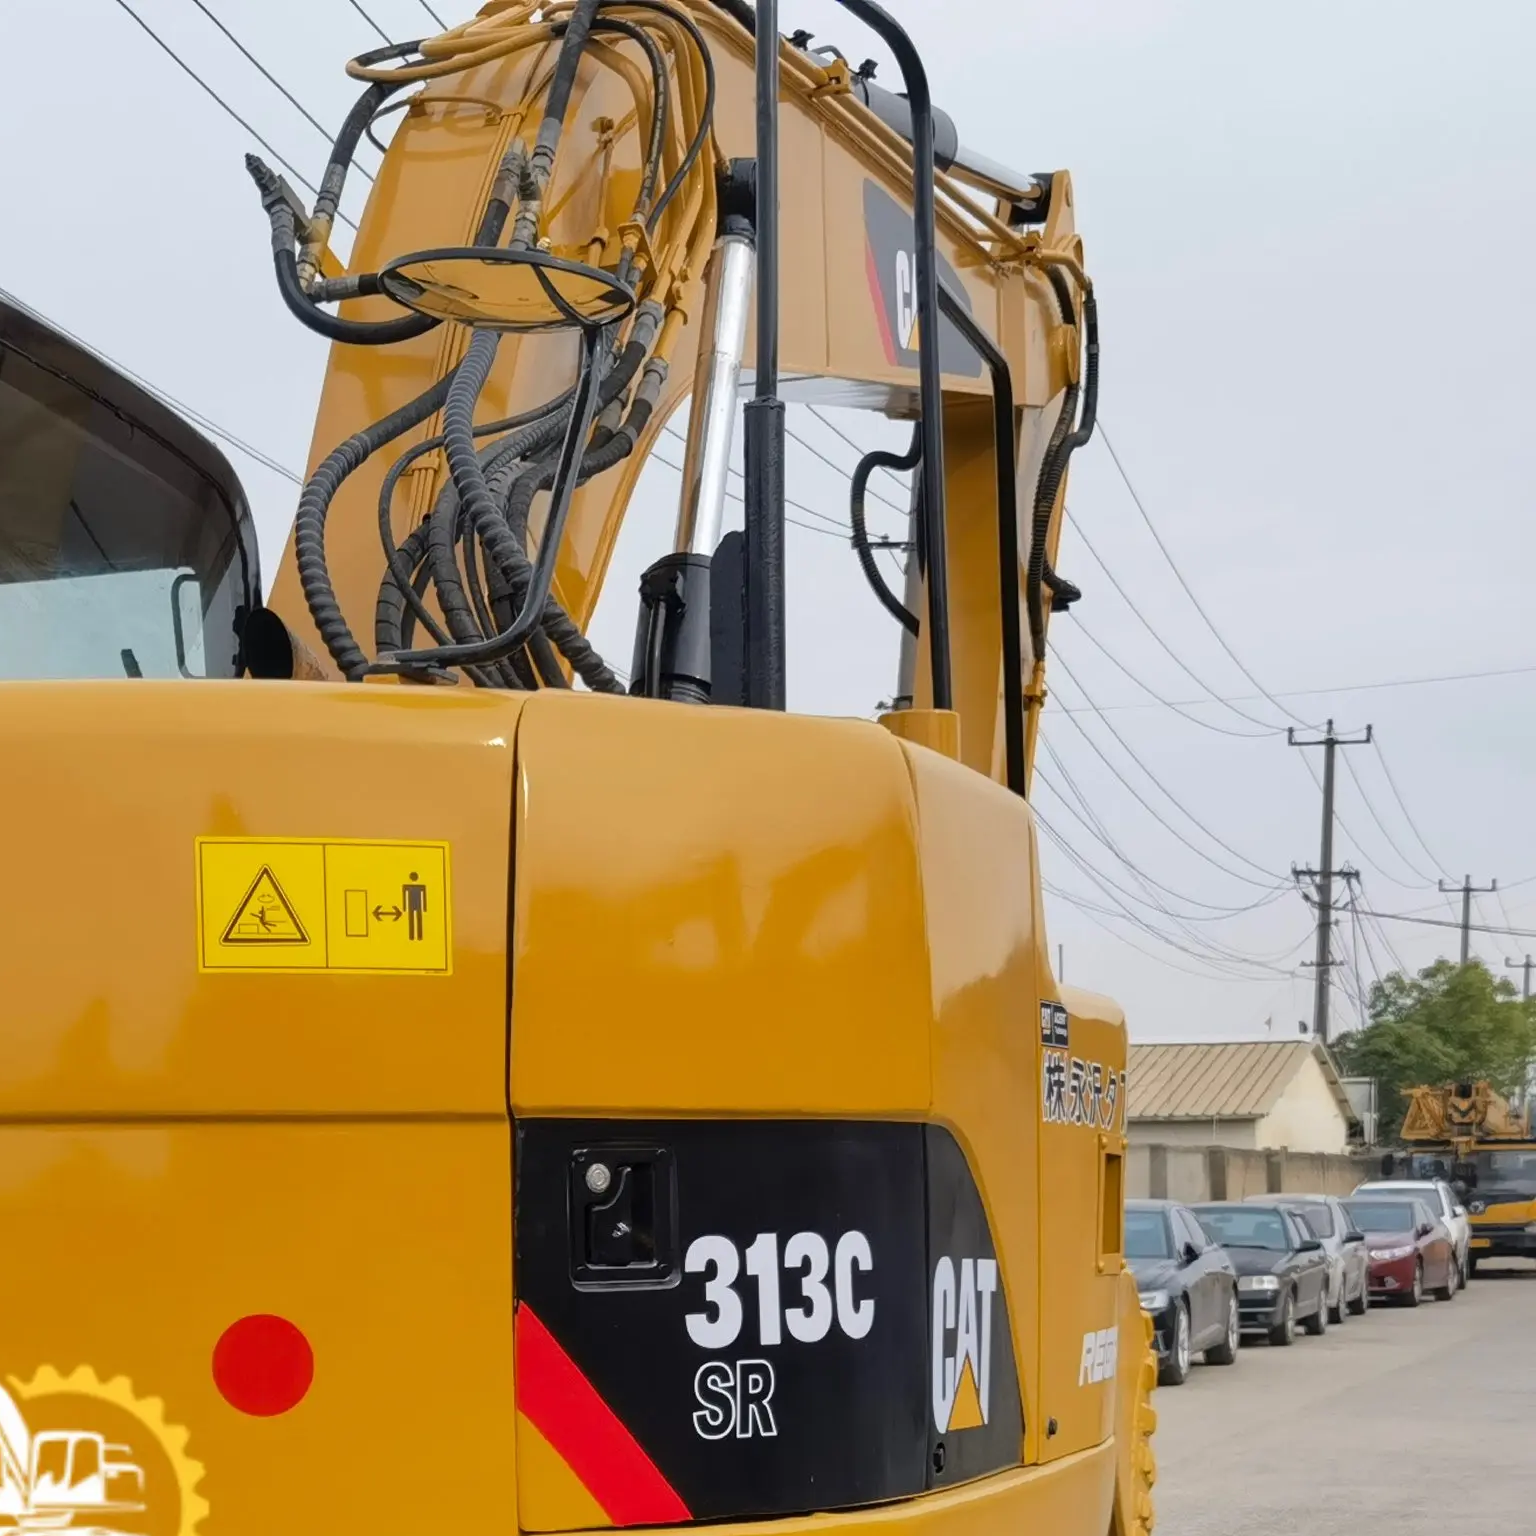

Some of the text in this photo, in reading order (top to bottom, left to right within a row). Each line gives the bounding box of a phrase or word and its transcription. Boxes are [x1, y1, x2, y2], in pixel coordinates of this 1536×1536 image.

[684, 1230, 875, 1349] 313C
[932, 1255, 997, 1434] CAT
[692, 1359, 778, 1440] SR
